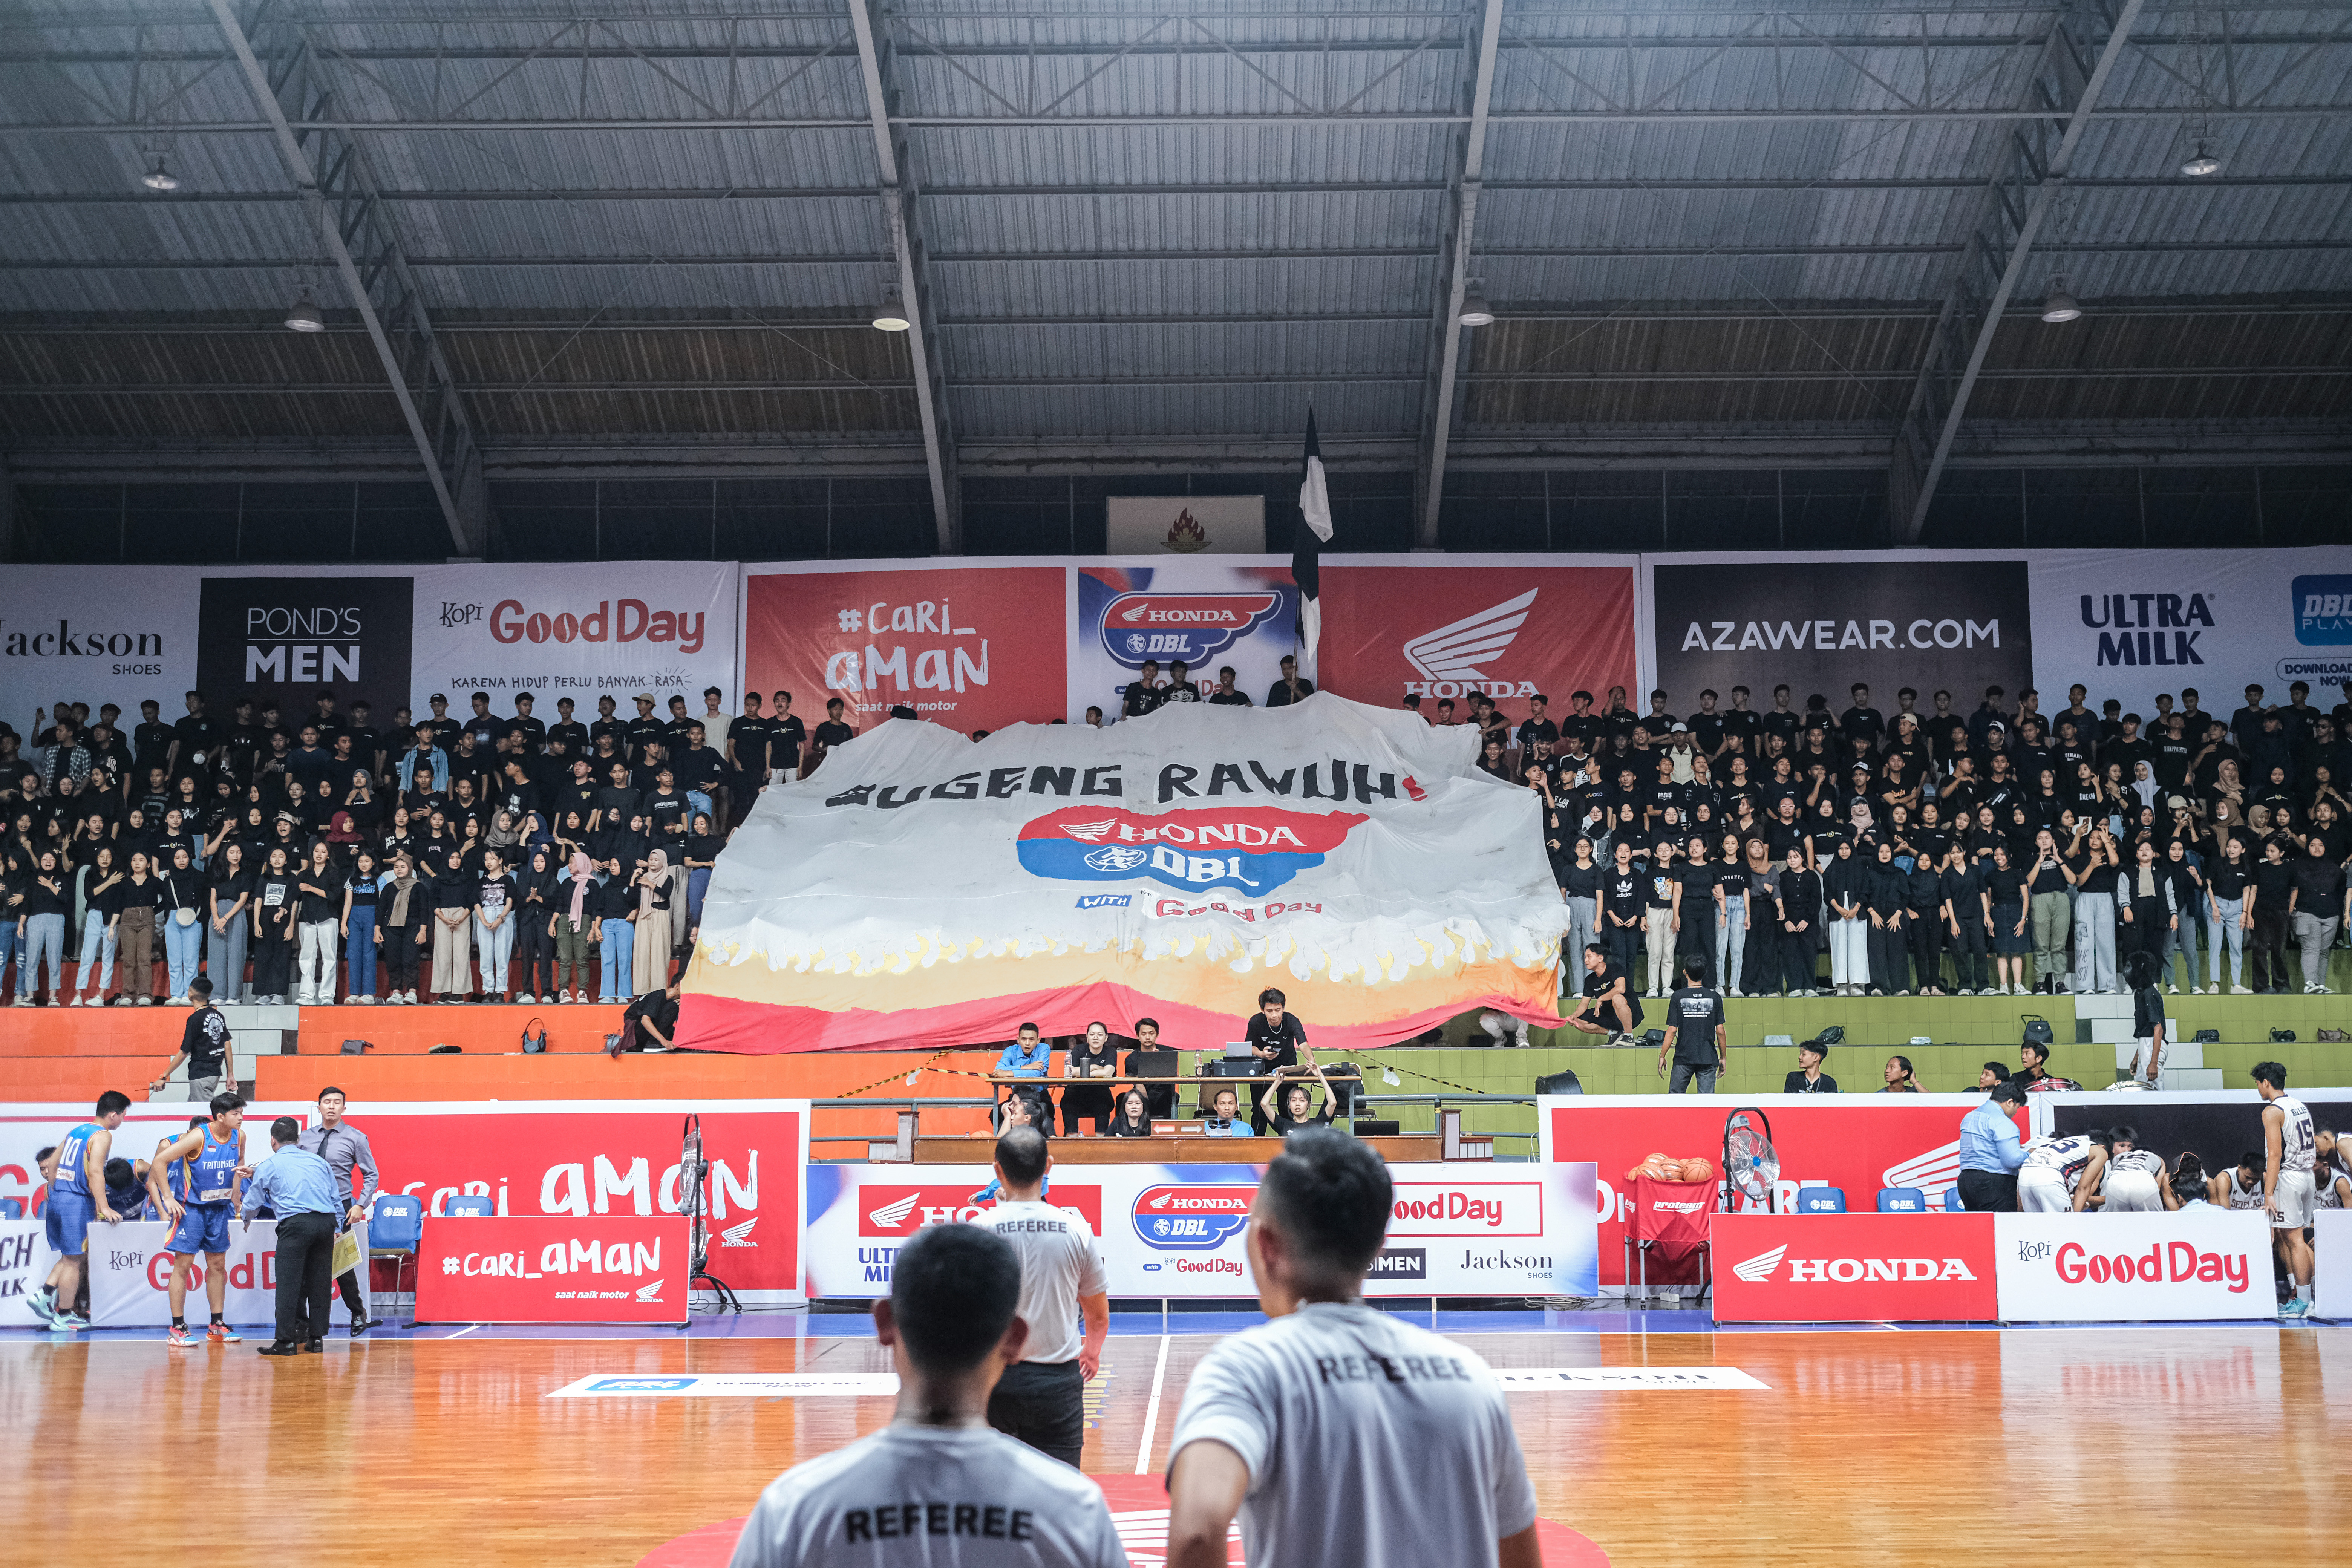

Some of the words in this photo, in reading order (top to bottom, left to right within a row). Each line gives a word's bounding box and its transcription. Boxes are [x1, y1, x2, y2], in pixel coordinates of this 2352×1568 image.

[1148, 610, 1237, 622] HONDA
[2081, 593, 2215, 628] ULTRA
[2302, 595, 2352, 617] DBL
[247, 608, 361, 635] POND'S
[0, 619, 164, 657] ackson
[1147, 634, 1191, 653] DBL
[1681, 619, 2000, 651] AZAWEAR.COM
[2097, 631, 2205, 666] MILK
[113, 664, 161, 675] SHOES
[246, 645, 360, 682] MEN
[2285, 664, 2352, 674] DOWNLOAD
[453, 677, 506, 689] KARENA
[512, 677, 548, 689] HIDUP
[555, 676, 591, 688] PERLU
[598, 676, 646, 688] BANYAK
[655, 676, 684, 687] RASA
[1201, 679, 1224, 696] Da
[1404, 681, 1540, 699] HONDA
[2320, 676, 2350, 686] NOW
[856, 702, 882, 712] saat
[916, 701, 957, 711] motor
[825, 764, 1122, 809] SUGENG
[1119, 823, 1307, 847] HONDA
[1150, 845, 1259, 887] DBL
[1084, 896, 1128, 907] WITH
[1156, 900, 1255, 922] Good
[2296, 1118, 2314, 1151] 15
[60, 1136, 83, 1166] 10
[217, 1171, 225, 1185] 9
[1172, 1198, 1248, 1209] HONDA
[1394, 1193, 1443, 1220] ood
[1449, 1192, 1502, 1227] Day
[1653, 1201, 1706, 1210] proteam
[996, 1220, 1067, 1234] REFEREE
[1171, 1219, 1208, 1236] DBL
[858, 1248, 905, 1264] ULT
[1378, 1256, 1421, 1271] MEN
[1460, 1249, 1553, 1269] Jackson
[147, 1251, 254, 1291] God
[864, 1266, 893, 1282] MI
[1788, 1258, 1978, 1282] HONDA
[555, 1291, 576, 1299] saat
[577, 1290, 599, 1299] naik
[600, 1291, 629, 1299] motor
[1318, 1355, 1473, 1384] REFEREE
[844, 1507, 1034, 1544] REFEREE
